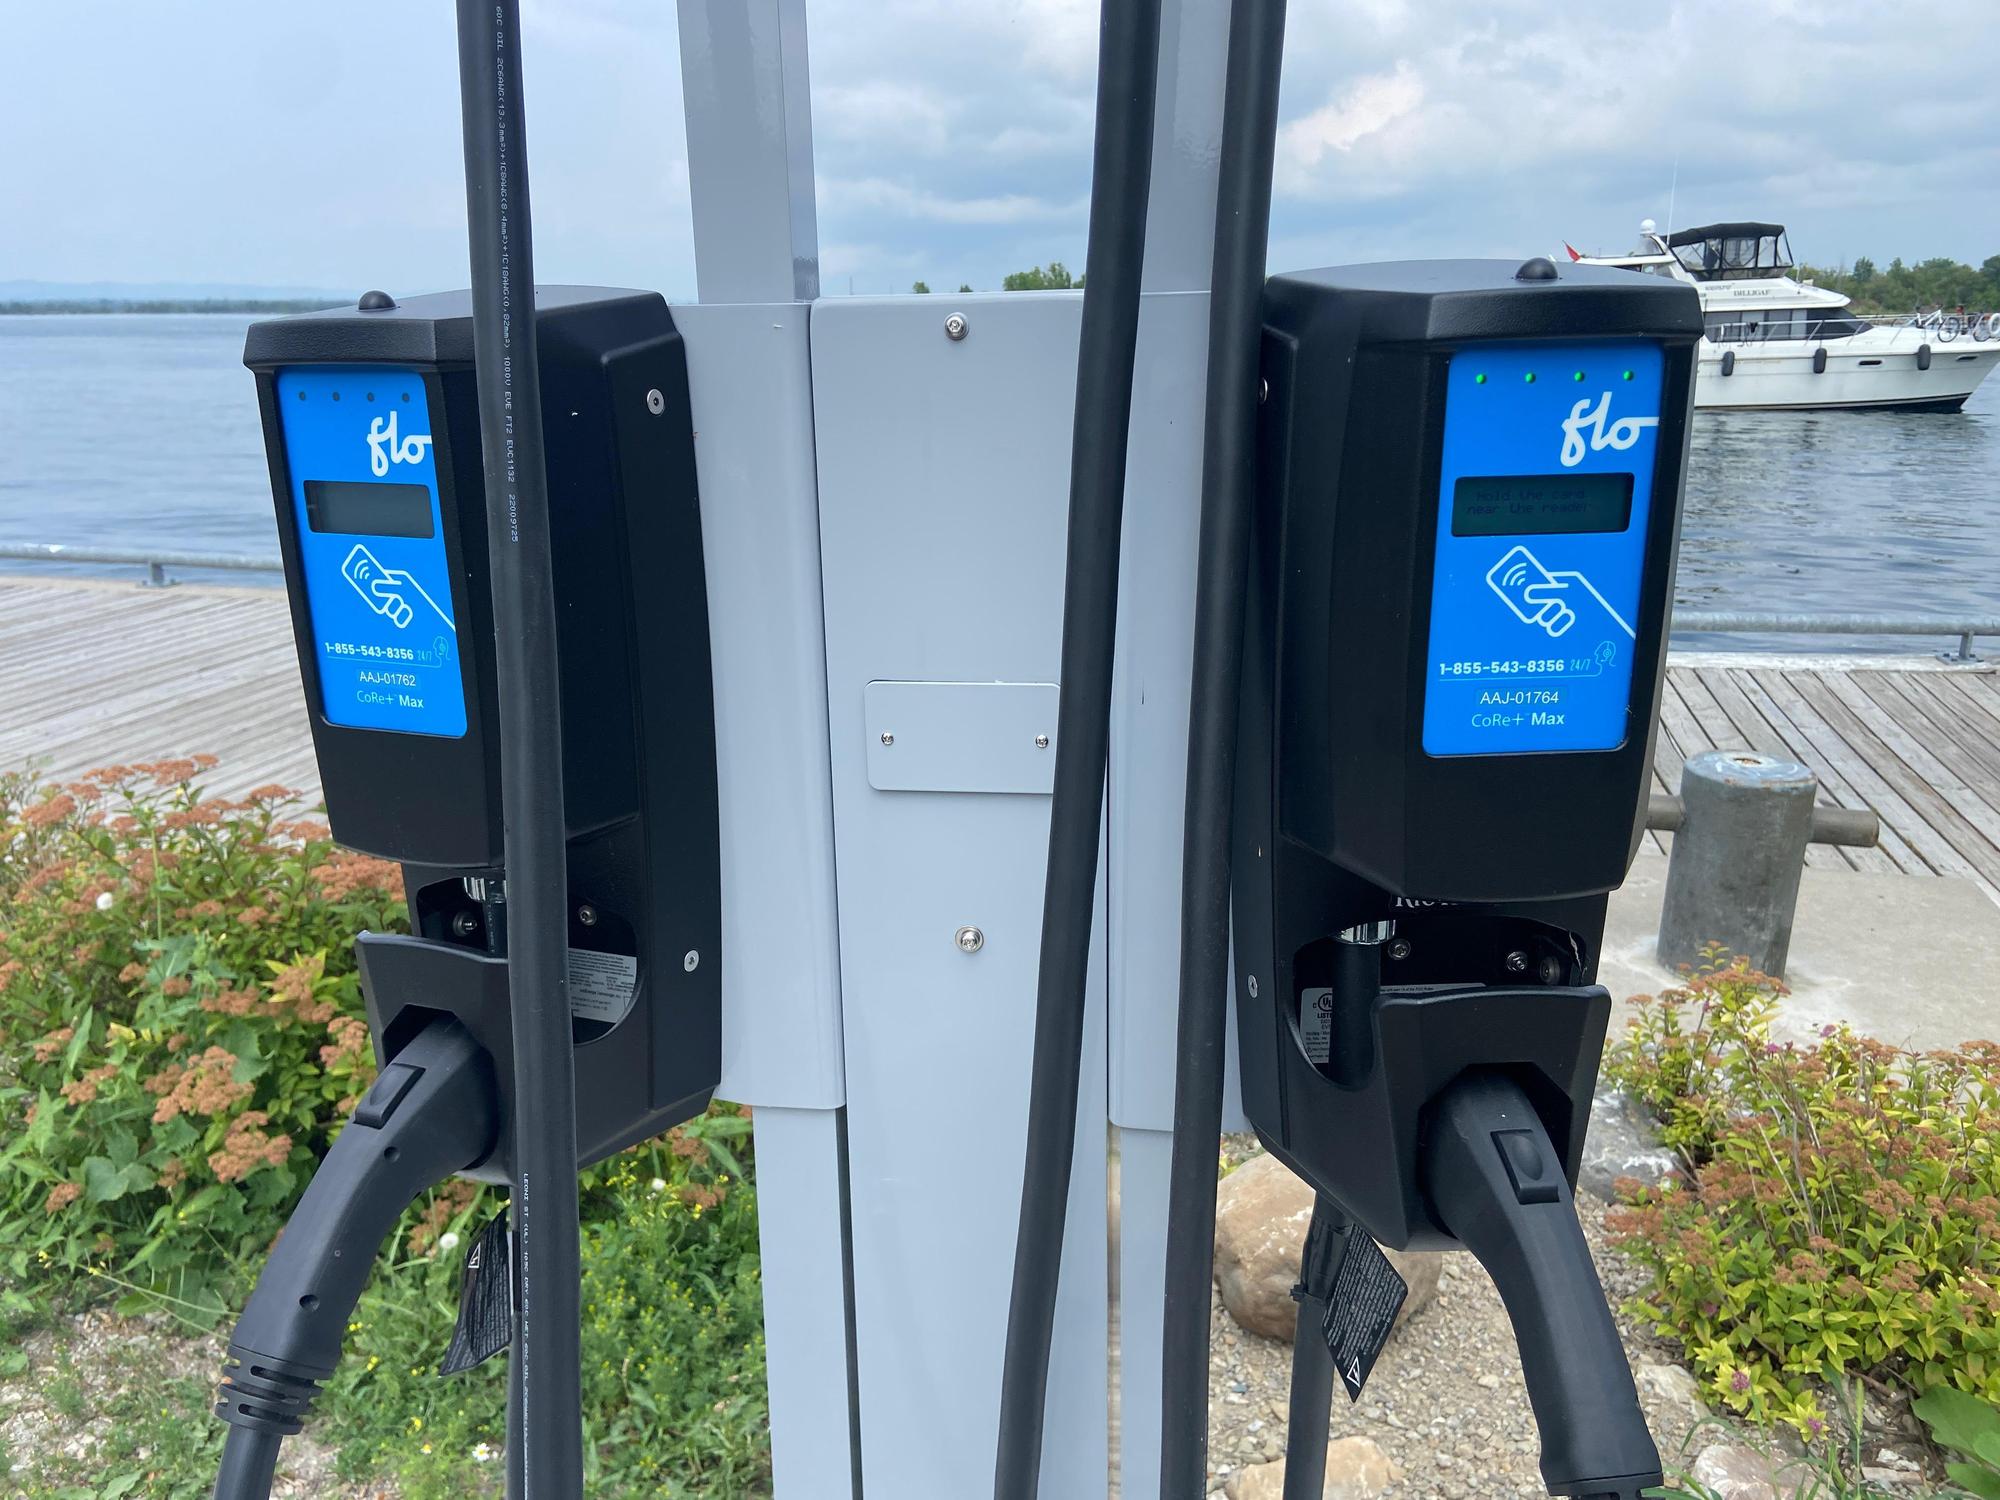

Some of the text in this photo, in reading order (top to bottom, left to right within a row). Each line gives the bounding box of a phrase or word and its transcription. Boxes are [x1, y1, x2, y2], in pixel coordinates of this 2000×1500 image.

[495, 31, 503, 51] OIL
[502, 356, 510, 387] 1000V
[504, 415, 512, 435] FT2
[1560, 391, 1660, 467] flo
[367, 410, 433, 477] flo
[325, 642, 414, 660] 1-855-543-8356
[1439, 658, 1591, 675] 1-855-543-8356 24/7
[359, 671, 417, 686] AAJ-01762
[399, 694, 424, 708] Max
[1480, 691, 1559, 705] AAJ-01764
[1531, 712, 1565, 726] Max
